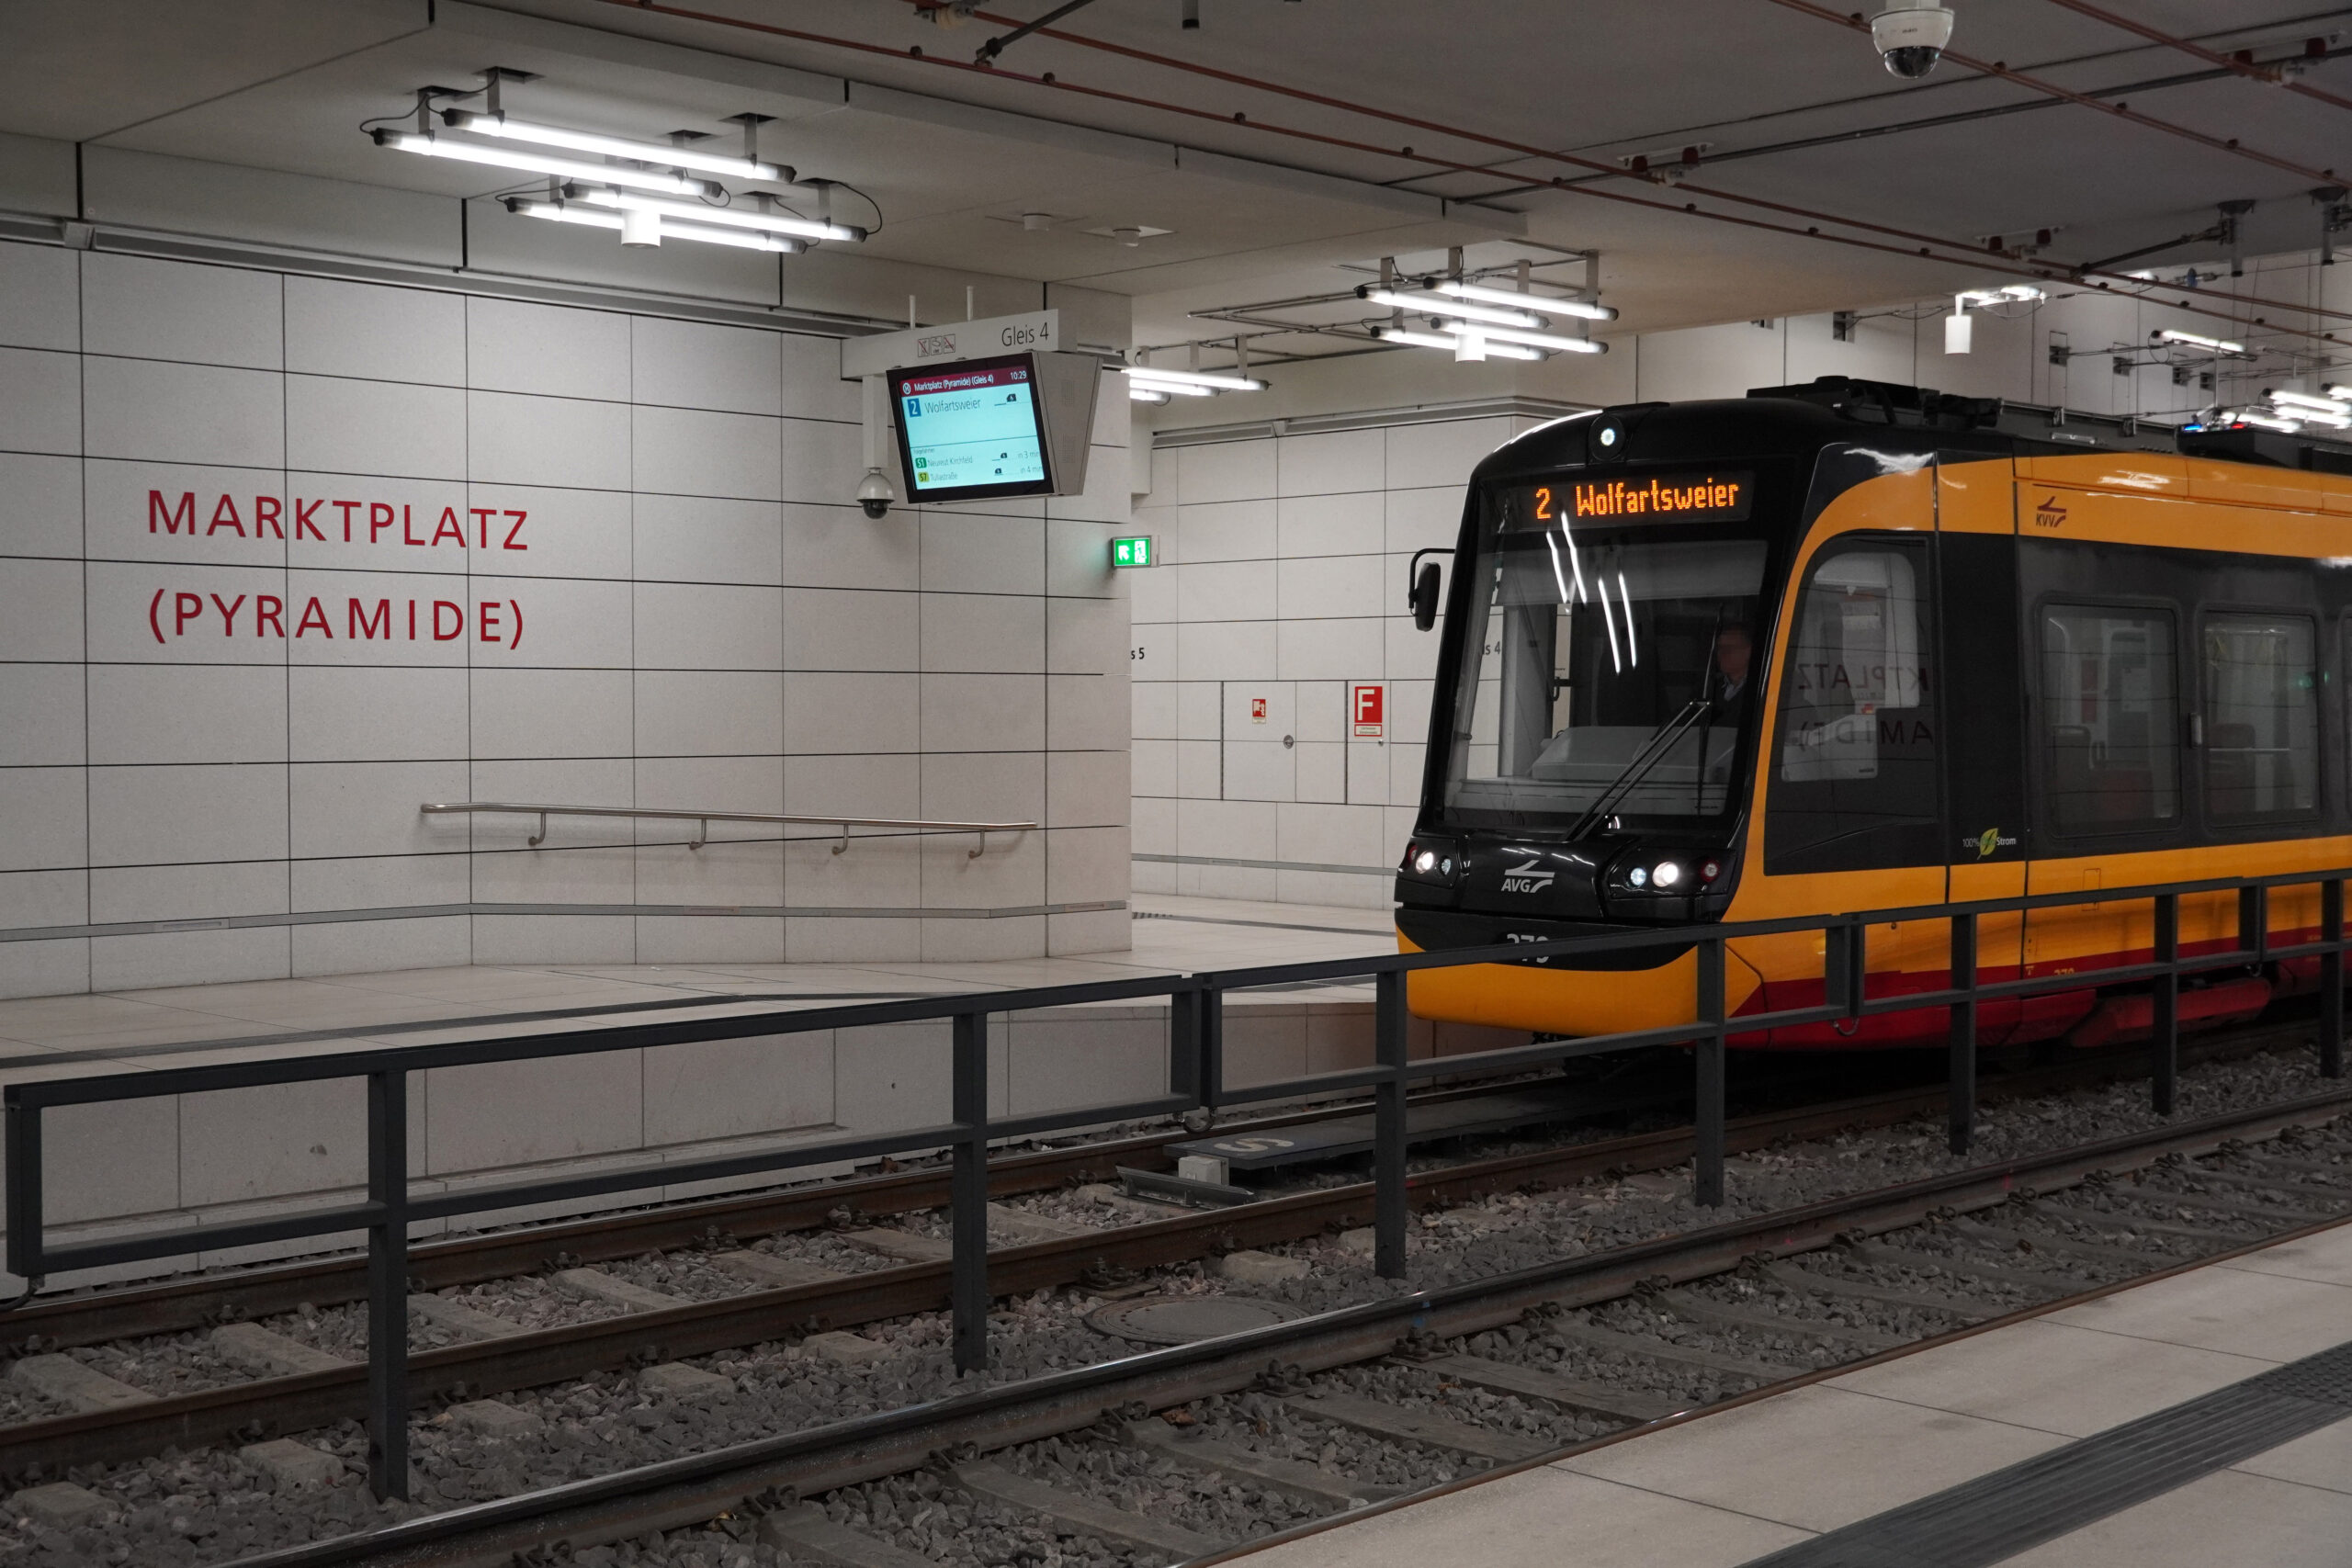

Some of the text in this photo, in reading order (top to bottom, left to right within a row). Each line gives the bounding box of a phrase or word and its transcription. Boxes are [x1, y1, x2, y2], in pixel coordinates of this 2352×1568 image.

[1001, 321, 1049, 346] Gleis 4
[914, 379, 943, 391] Marktplatz
[943, 377, 971, 389] (Pyramide)
[971, 375, 987, 386] (Gleis
[988, 374, 994, 384] 4)
[1011, 370, 1027, 380] 10:29
[910, 398, 981, 415] 2 Wolfartsweier
[917, 458, 926, 468] S1
[919, 473, 928, 481] S7
[1535, 477, 1739, 520] 2 Wolfartsweier
[148, 489, 528, 551] MARKTPLATZ
[2035, 513, 2055, 528] KVV
[149, 588, 524, 650] (PYRAMIDE)
[1138, 647, 1145, 660] 5
[1494, 640, 1501, 655] 4
[1357, 689, 1375, 721] F
[1996, 836, 2017, 846] Strom
[1500, 878, 1532, 893] AVG
